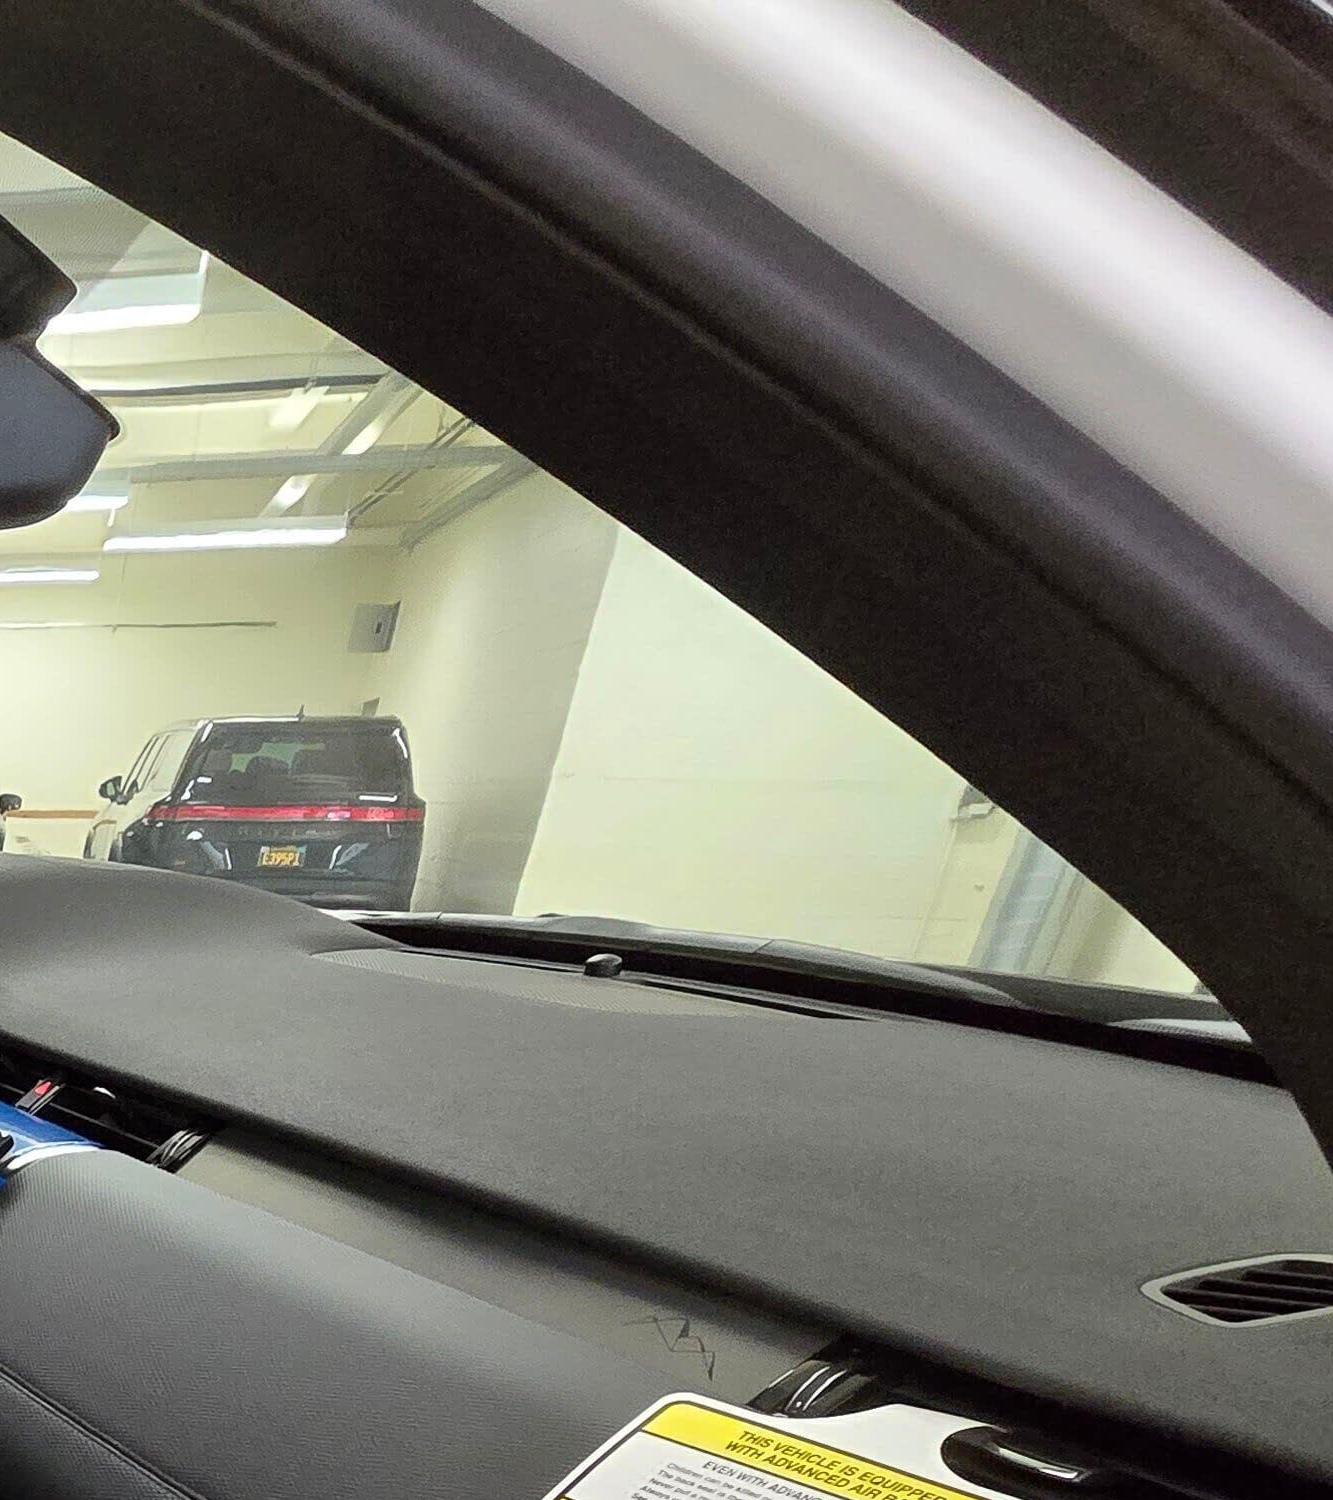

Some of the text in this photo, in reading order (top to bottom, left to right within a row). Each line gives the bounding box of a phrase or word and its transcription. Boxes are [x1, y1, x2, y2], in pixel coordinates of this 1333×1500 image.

[701, 1460, 738, 1477] EVEN
[734, 1471, 770, 1488] WITH
[723, 1440, 766, 1460] WITH
[761, 1453, 852, 1489] ADVANCED
[846, 1482, 883, 1499] AIR
[735, 1430, 776, 1449] THIS
[770, 1441, 842, 1471] VEHICLE
[836, 1464, 861, 1477] IS
